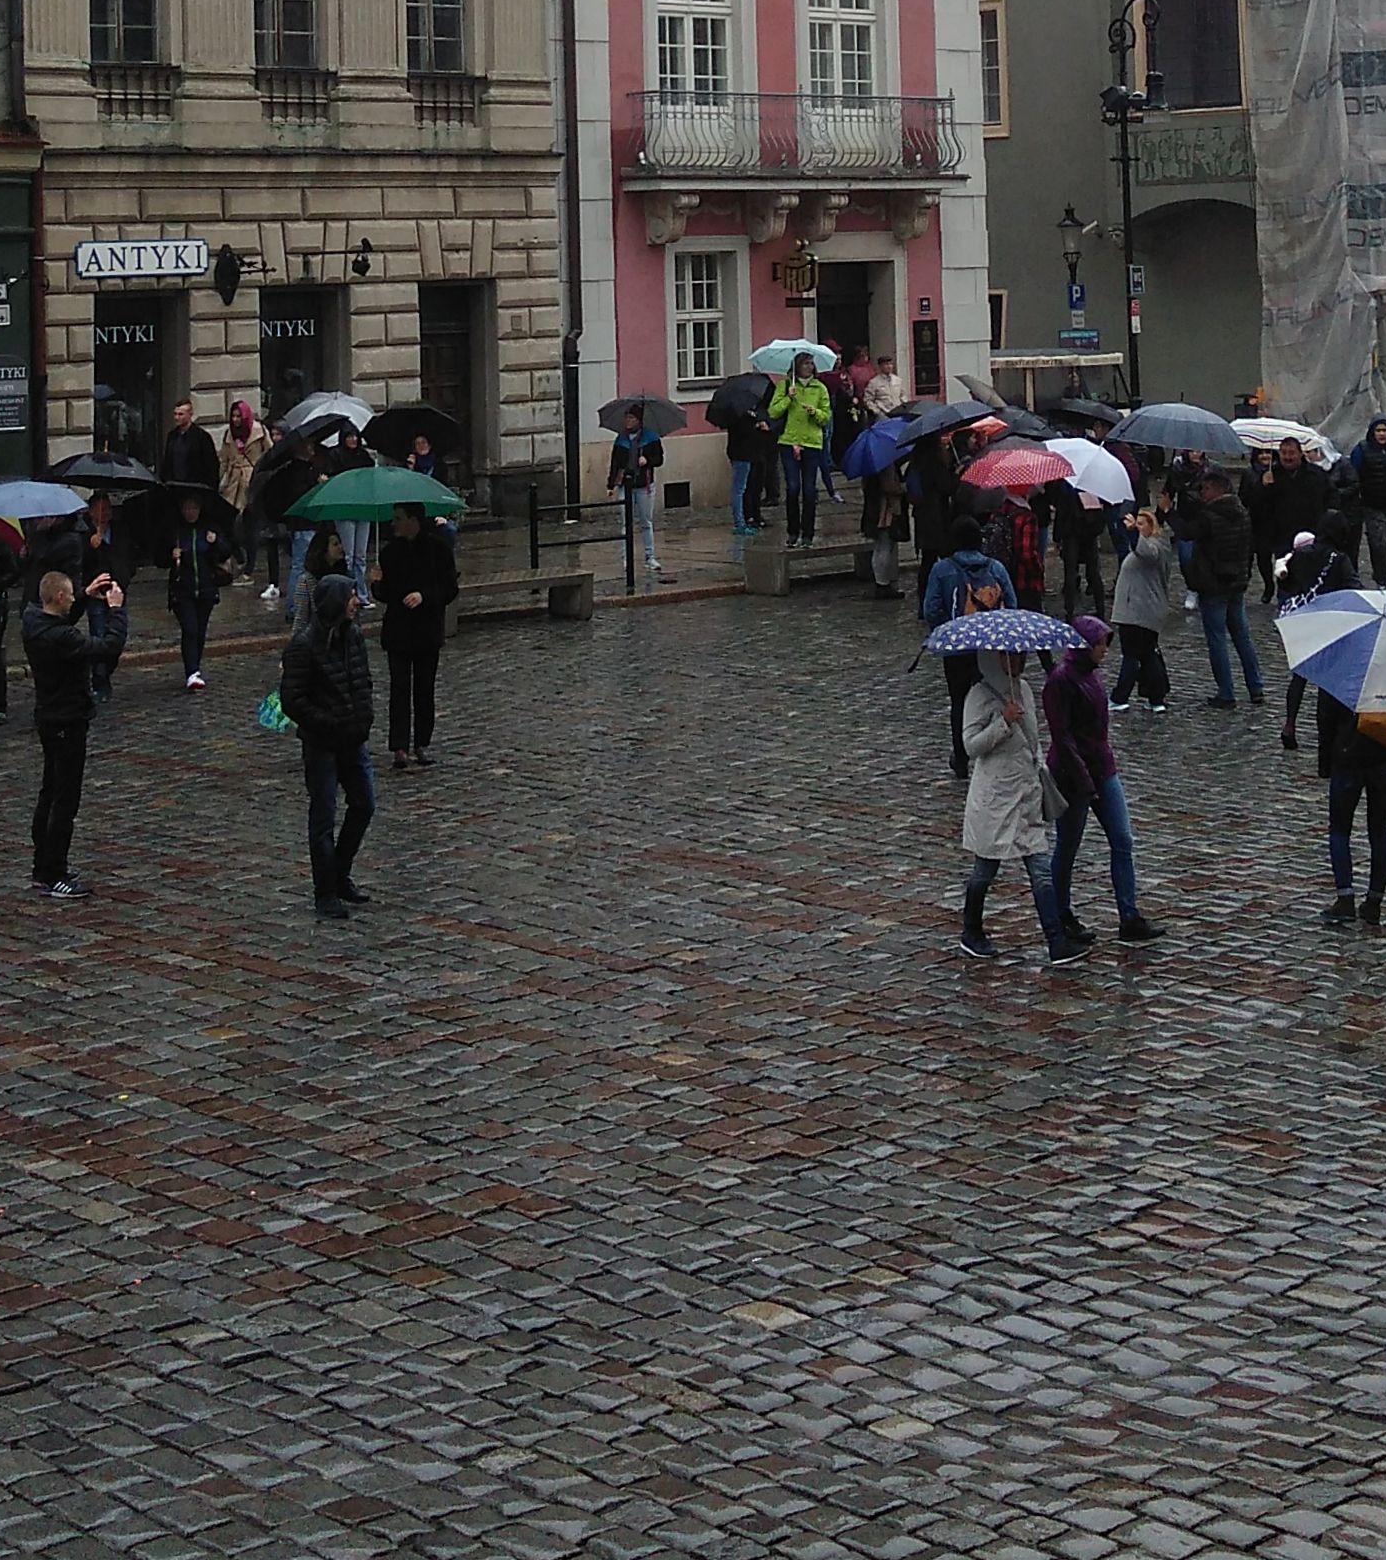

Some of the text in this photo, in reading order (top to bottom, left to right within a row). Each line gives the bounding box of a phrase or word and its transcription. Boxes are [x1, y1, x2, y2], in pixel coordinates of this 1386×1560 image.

[84, 244, 205, 273] ANTYKI
[1072, 286, 1081, 302] P
[96, 324, 155, 345] NTYKI
[261, 319, 315, 338] NTYKI
